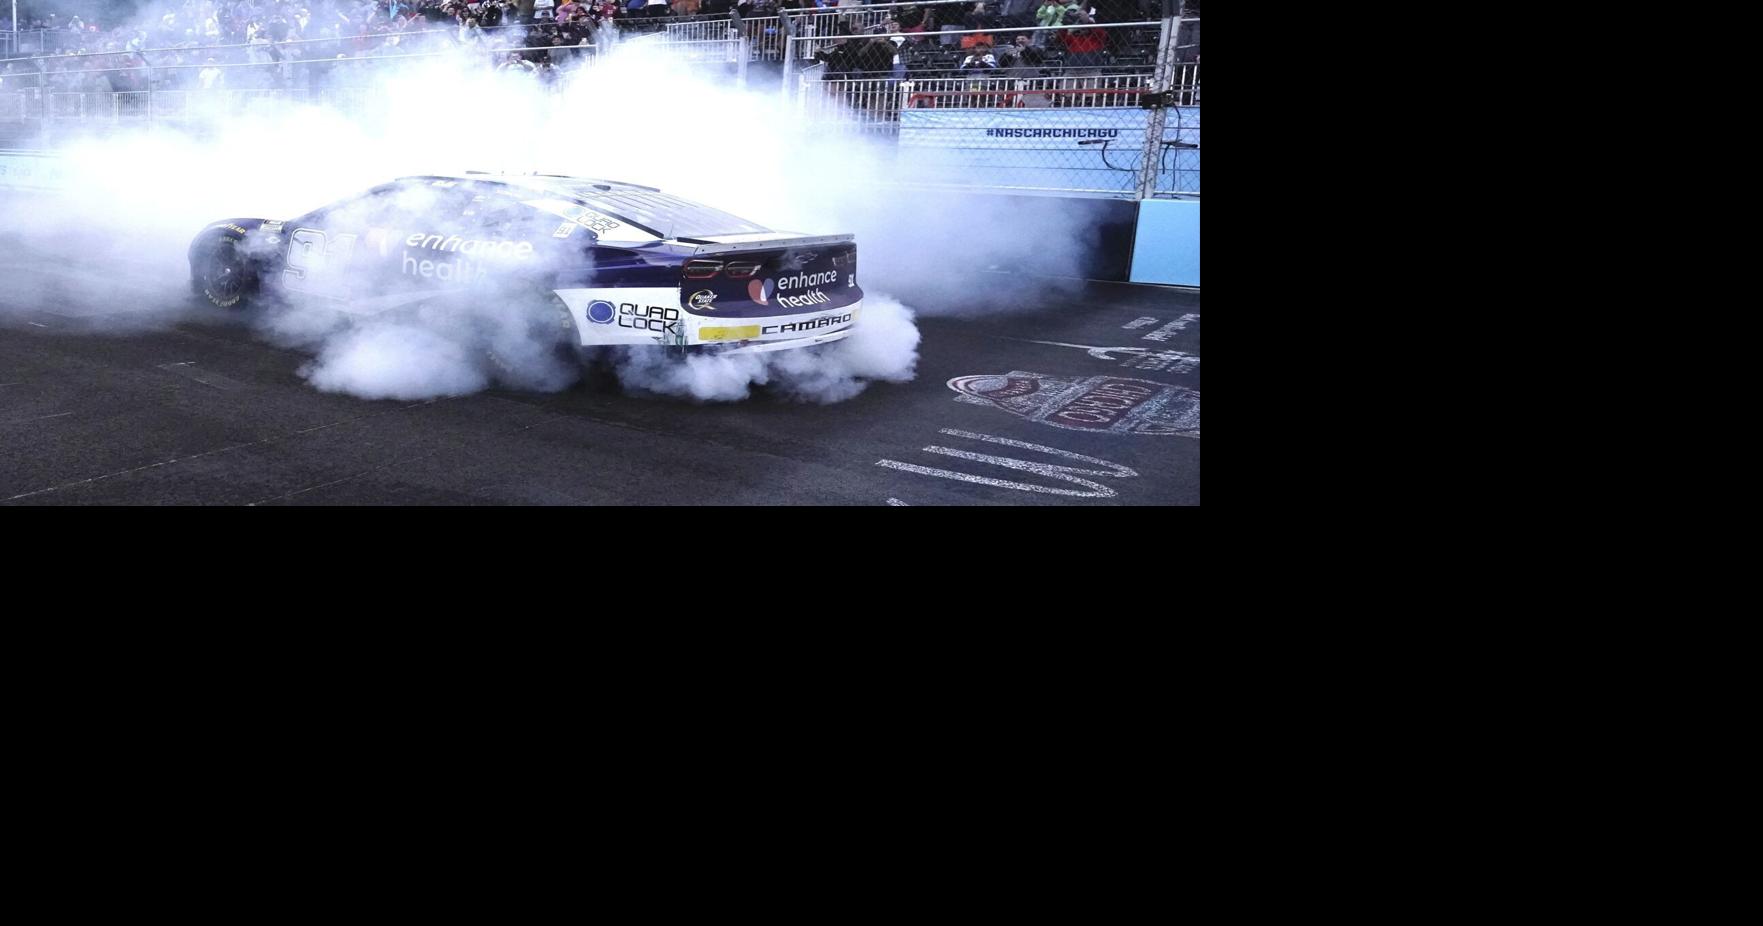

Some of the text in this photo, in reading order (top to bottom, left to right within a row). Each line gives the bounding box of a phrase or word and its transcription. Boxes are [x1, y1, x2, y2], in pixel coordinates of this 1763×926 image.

[986, 127, 1118, 139] #NASCARCHICAGO
[405, 231, 534, 260] enhance
[777, 269, 838, 290] enhance
[776, 288, 831, 309] health
[619, 302, 680, 322] QUAD
[618, 315, 677, 335] LOCK
[761, 313, 852, 335] CAMARO
